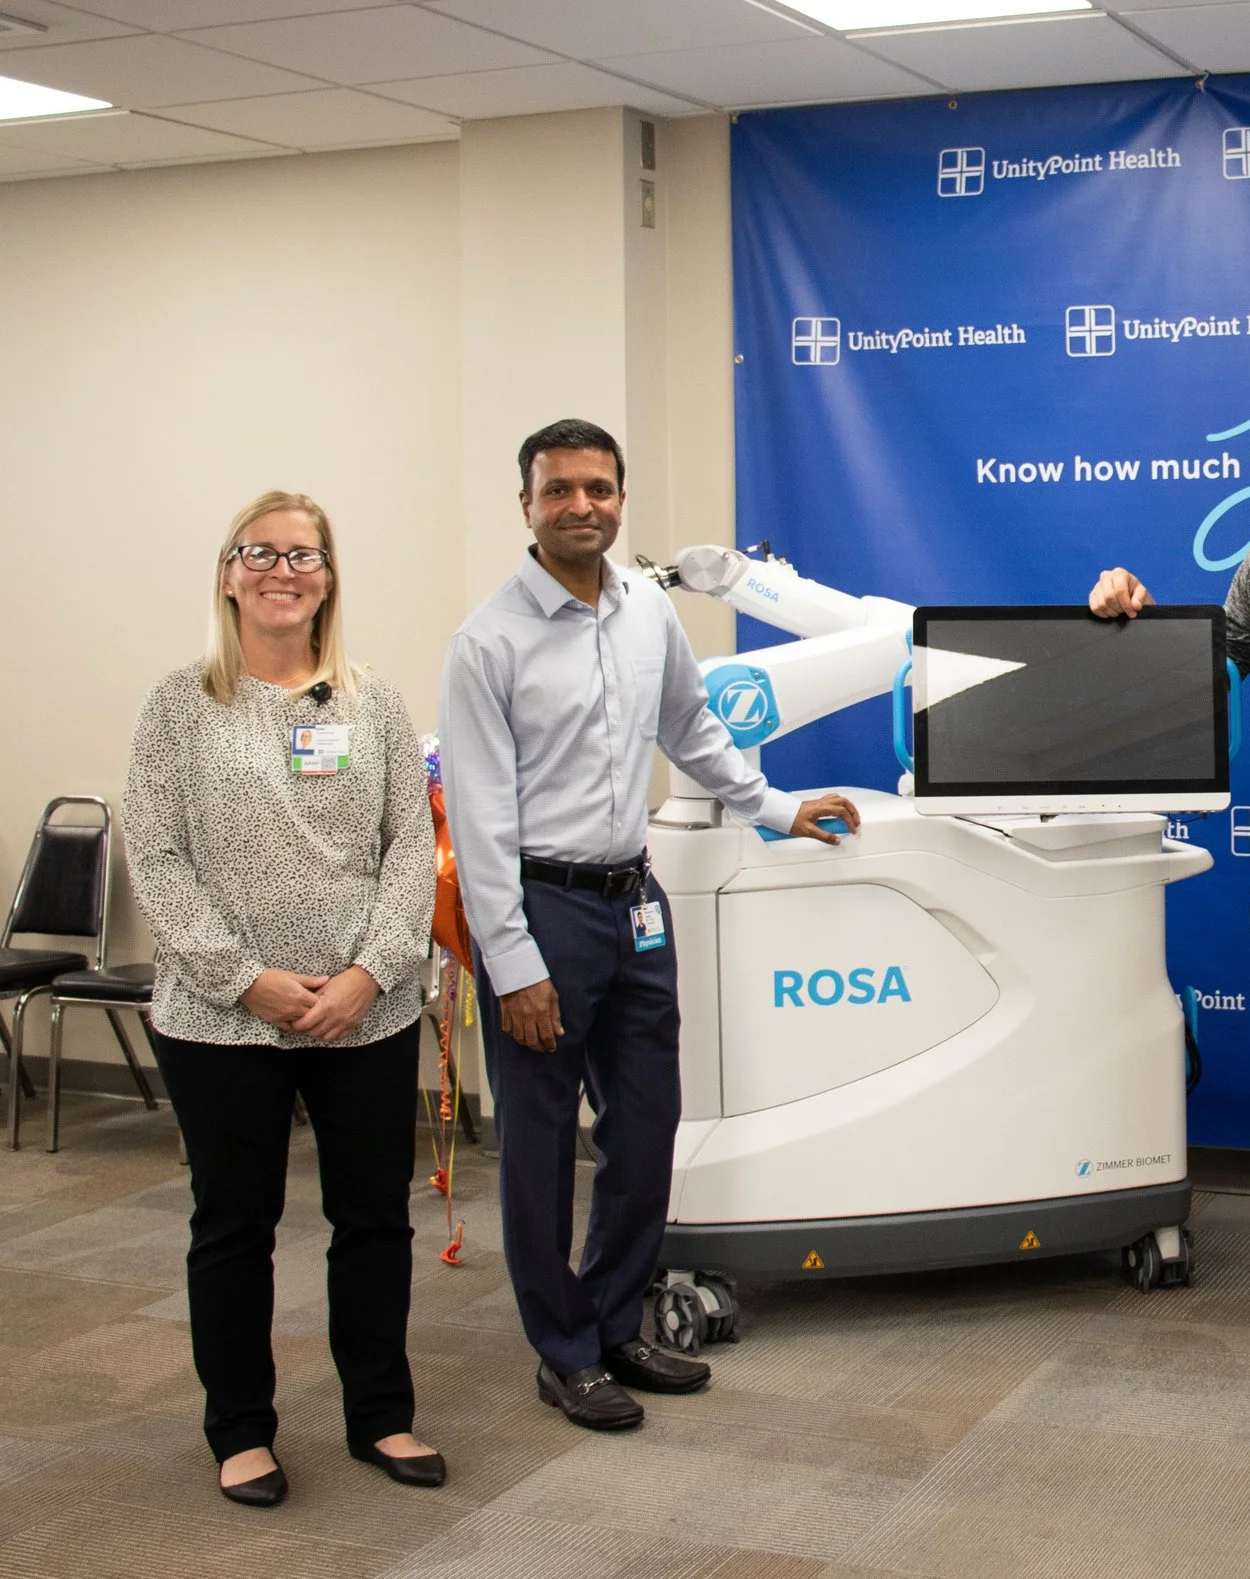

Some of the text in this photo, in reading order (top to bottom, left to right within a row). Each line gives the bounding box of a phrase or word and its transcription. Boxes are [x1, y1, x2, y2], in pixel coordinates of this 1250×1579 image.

[992, 148, 1181, 180] UnityPoint Health
[848, 324, 1027, 354] UnityPoint Health
[1123, 316, 1240, 342] UnityPoint
[976, 458, 1064, 483] Know
[1074, 455, 1141, 482] how
[1151, 452, 1241, 480] much
[747, 578, 780, 604] ROSA
[773, 965, 913, 1008] ROSA
[1096, 1154, 1172, 1171] ZIMMER BIOMET
